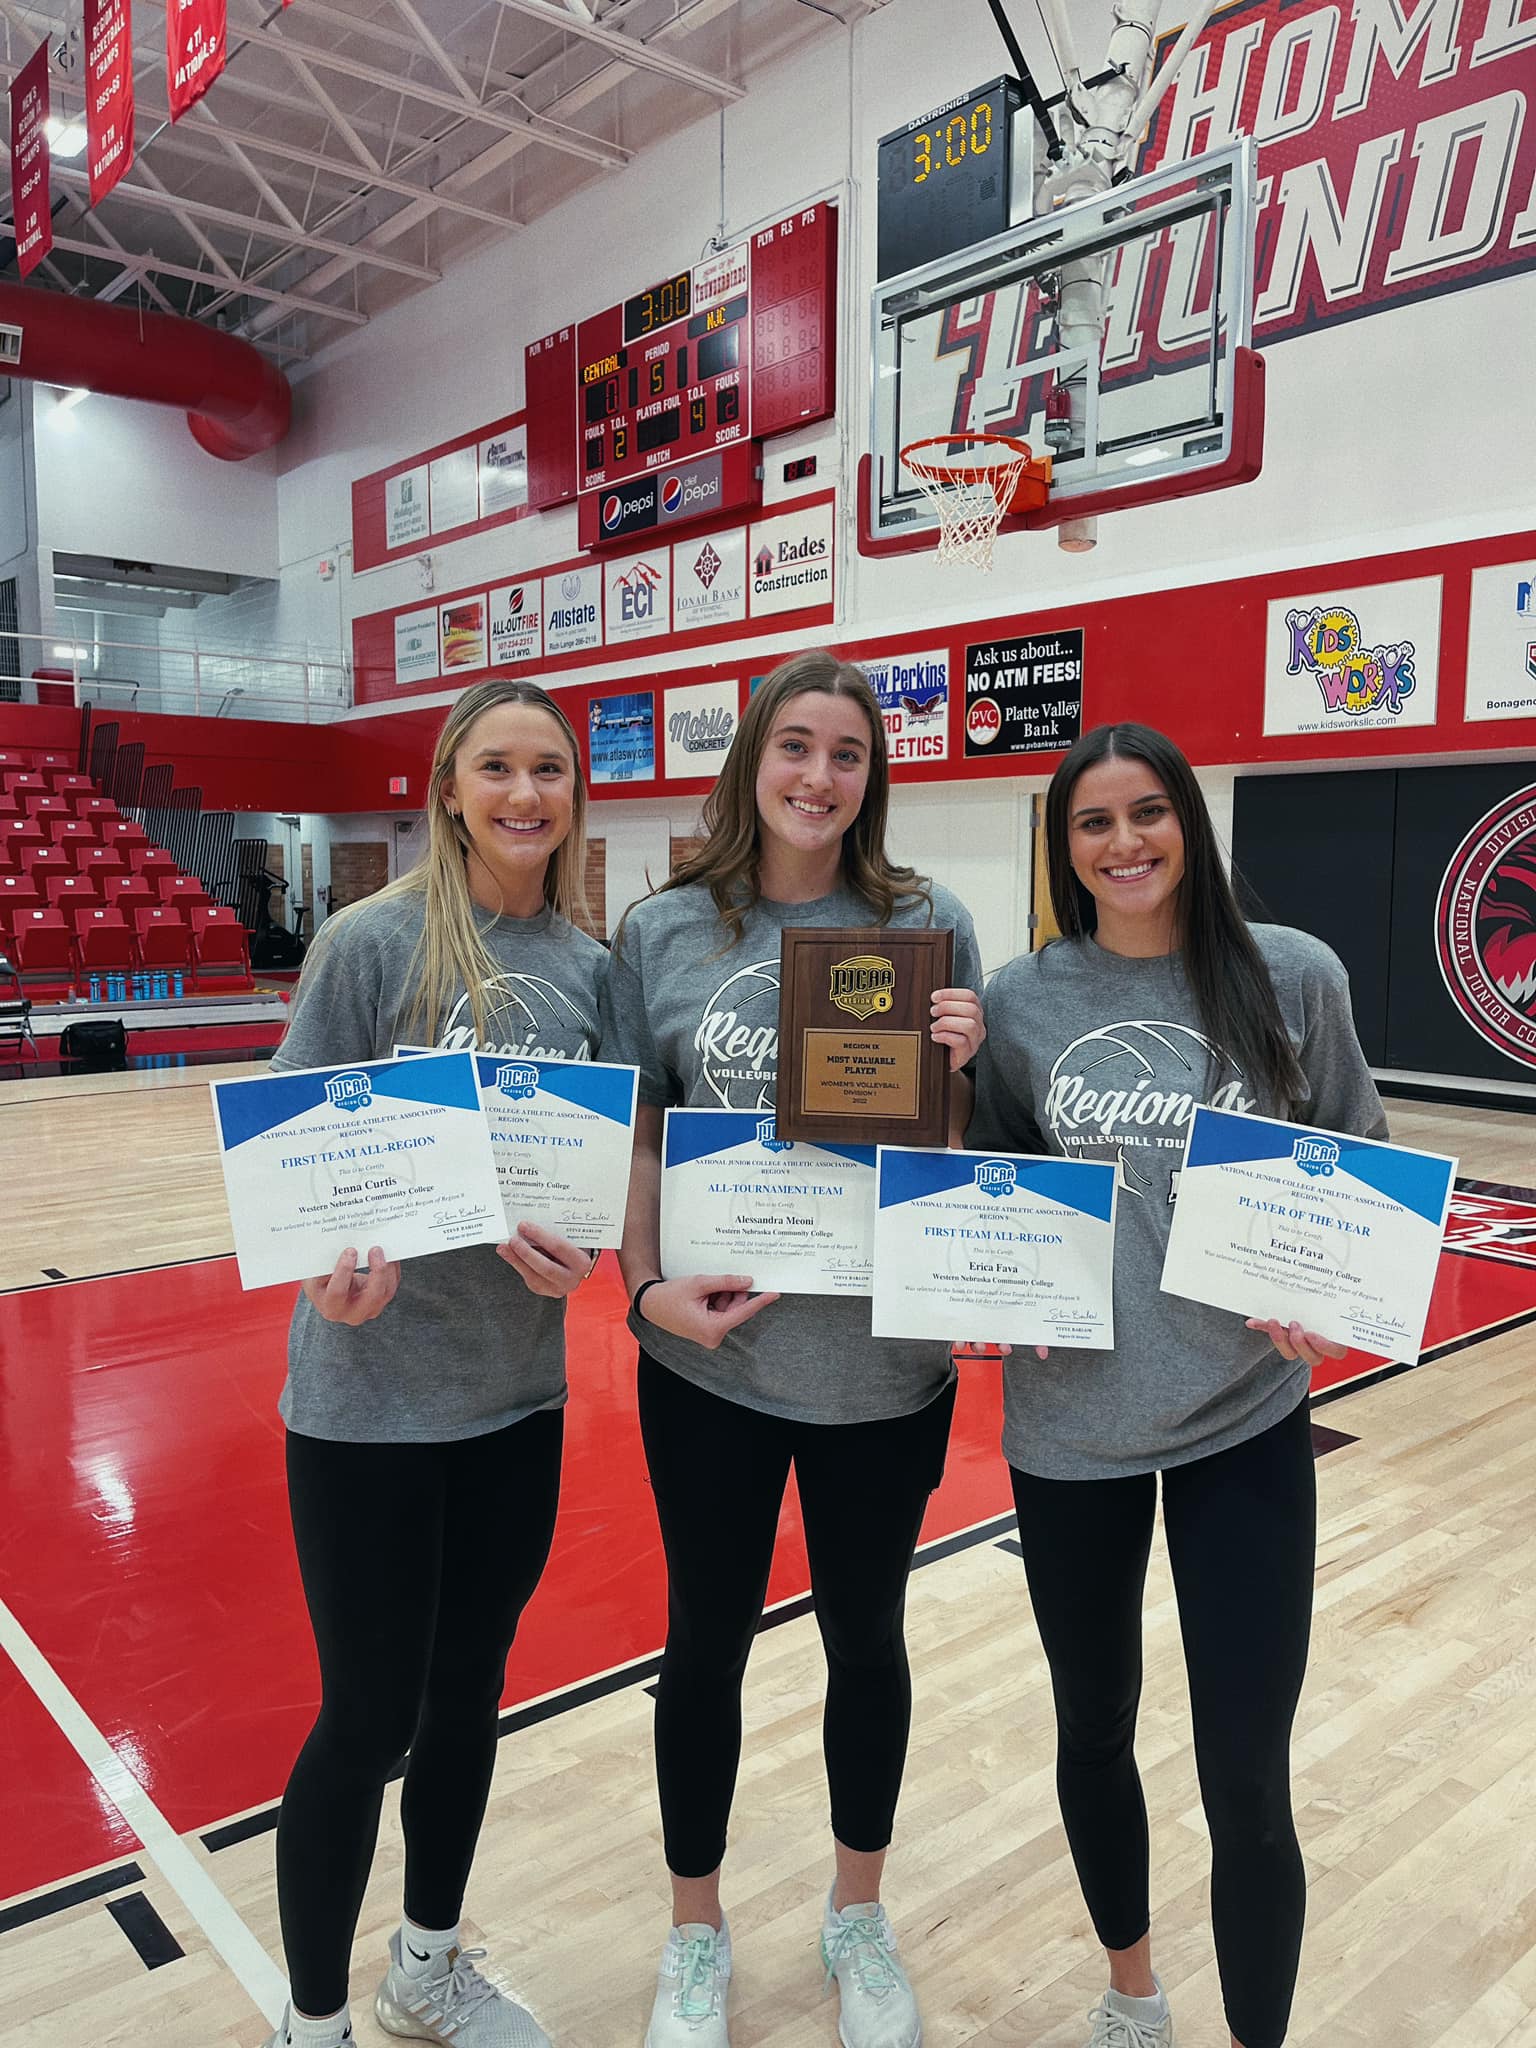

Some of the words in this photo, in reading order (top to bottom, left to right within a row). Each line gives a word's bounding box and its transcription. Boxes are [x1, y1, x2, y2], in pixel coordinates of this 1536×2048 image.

[908, 93, 970, 131] DAKTRONICS
[914, 103, 992, 183] 3:00
[757, 230, 774, 248] PLYR
[780, 220, 794, 236] FLS
[802, 209, 816, 226] PTS
[642, 276, 688, 332] 3:00
[645, 342, 670, 362] PERIOD
[584, 354, 621, 383] CENTRAL
[653, 364, 662, 392] 5
[585, 424, 605, 440] FOULS
[636, 401, 662, 421] PLAYER
[663, 395, 681, 413] FOUL
[715, 372, 739, 391] FOULS
[616, 430, 625, 458] 2
[693, 403, 703, 427] 4
[715, 424, 740, 443] SCORE
[646, 448, 670, 467] MATCH
[585, 471, 606, 487] SCORE
[684, 477, 718, 506] pepsi
[623, 491, 654, 518] pepsi
[777, 536, 826, 563] Eades
[754, 566, 828, 594] Construction
[622, 581, 653, 621] ECI
[549, 604, 595, 630] Allstate
[973, 649, 999, 667] Ask
[1001, 648, 1017, 662] us
[1020, 640, 1073, 661] about...
[861, 664, 890, 673] Senator
[865, 672, 888, 693] ew
[892, 661, 945, 693] Perkins
[967, 672, 991, 693] NO
[994, 667, 1028, 690] ATM
[1033, 660, 1080, 685] FEES!
[971, 708, 996, 724] PVC
[1005, 705, 1039, 722] Platte
[1041, 701, 1080, 719] Valley
[669, 707, 734, 743] Mobile
[1024, 720, 1059, 738] Bank
[1297, 716, 1396, 731] www.kidsworksllc.com
[591, 747, 654, 763] www.atlaswy.com
[688, 738, 726, 751] CONCRETE
[1010, 739, 1072, 751] www.pvbankwy.com
[1456, 878, 1477, 965] NATIONAL
[832, 967, 893, 999] NJCAA
[879, 998, 887, 1007] 9
[1466, 973, 1511, 1026] JUNIOR
[827, 1056, 850, 1064] MOST
[852, 1056, 896, 1065] VALUABLE
[845, 1067, 877, 1075] PLAYER
[498, 1069, 537, 1088] NJCAA
[856, 1081, 901, 1089] VOLLEYBALL
[327, 1078, 370, 1103] NJCAA
[1045, 1075, 1193, 1135] Region
[260, 1130, 298, 1141] NATIONAL
[300, 1125, 326, 1137] JUNIOR
[327, 1120, 360, 1131] COLLEGE
[362, 1114, 397, 1125] ATHLETIC
[400, 1107, 446, 1120] ASSOCIATION
[281, 1154, 317, 1169] FIRST
[320, 1148, 356, 1163] TEAM
[360, 1135, 436, 1157] ALL-REGION
[550, 1136, 583, 1147] TEAM
[1064, 1135, 1151, 1148] VOLLEYBALL
[1293, 1141, 1338, 1161] NJCAA
[509, 1165, 539, 1176] Curtis
[976, 1166, 1015, 1185] NJCAA
[332, 1185, 362, 1197] Jenna
[365, 1177, 397, 1190] Curtis
[506, 1179, 544, 1190] Community
[546, 1181, 570, 1190] College
[708, 1183, 809, 1194] ALL-TOURNAMENT
[813, 1186, 844, 1195] TEAM
[1219, 1165, 1253, 1178] NATIONAL
[1256, 1173, 1282, 1185] JUNIOR
[1282, 1178, 1315, 1192] COLLEGE
[1318, 1186, 1354, 1201] ATHLETIC
[1355, 1195, 1404, 1213] ASSOCIATION
[299, 1204, 328, 1214] Western
[330, 1197, 364, 1209] Nebraska
[365, 1189, 406, 1202] Community
[408, 1185, 434, 1195] College
[735, 1215, 783, 1225] Alessandra
[786, 1216, 814, 1226] Meoni
[1239, 1196, 1286, 1216] PLAYER
[1289, 1208, 1306, 1220] OF
[1309, 1213, 1334, 1227] THE
[1336, 1219, 1371, 1237] YEAR
[772, 1229, 809, 1238] Community
[811, 1230, 834, 1238] College
[925, 1226, 956, 1238] FIRST
[959, 1229, 991, 1240] TEAM
[993, 1231, 1063, 1244] ALL-REGION
[1270, 1238, 1297, 1254] Erica
[1299, 1246, 1324, 1261] Fava
[969, 1262, 994, 1272] Erica
[996, 1263, 1019, 1274] Fava
[1230, 1242, 1257, 1256] Western
[1258, 1249, 1292, 1265] Nebraska
[1292, 1258, 1334, 1277] Community
[1335, 1270, 1362, 1284] College
[933, 1273, 960, 1282] Western
[961, 1275, 991, 1284] Nebraska
[992, 1277, 1031, 1287] Community
[1031, 1279, 1054, 1288] College
